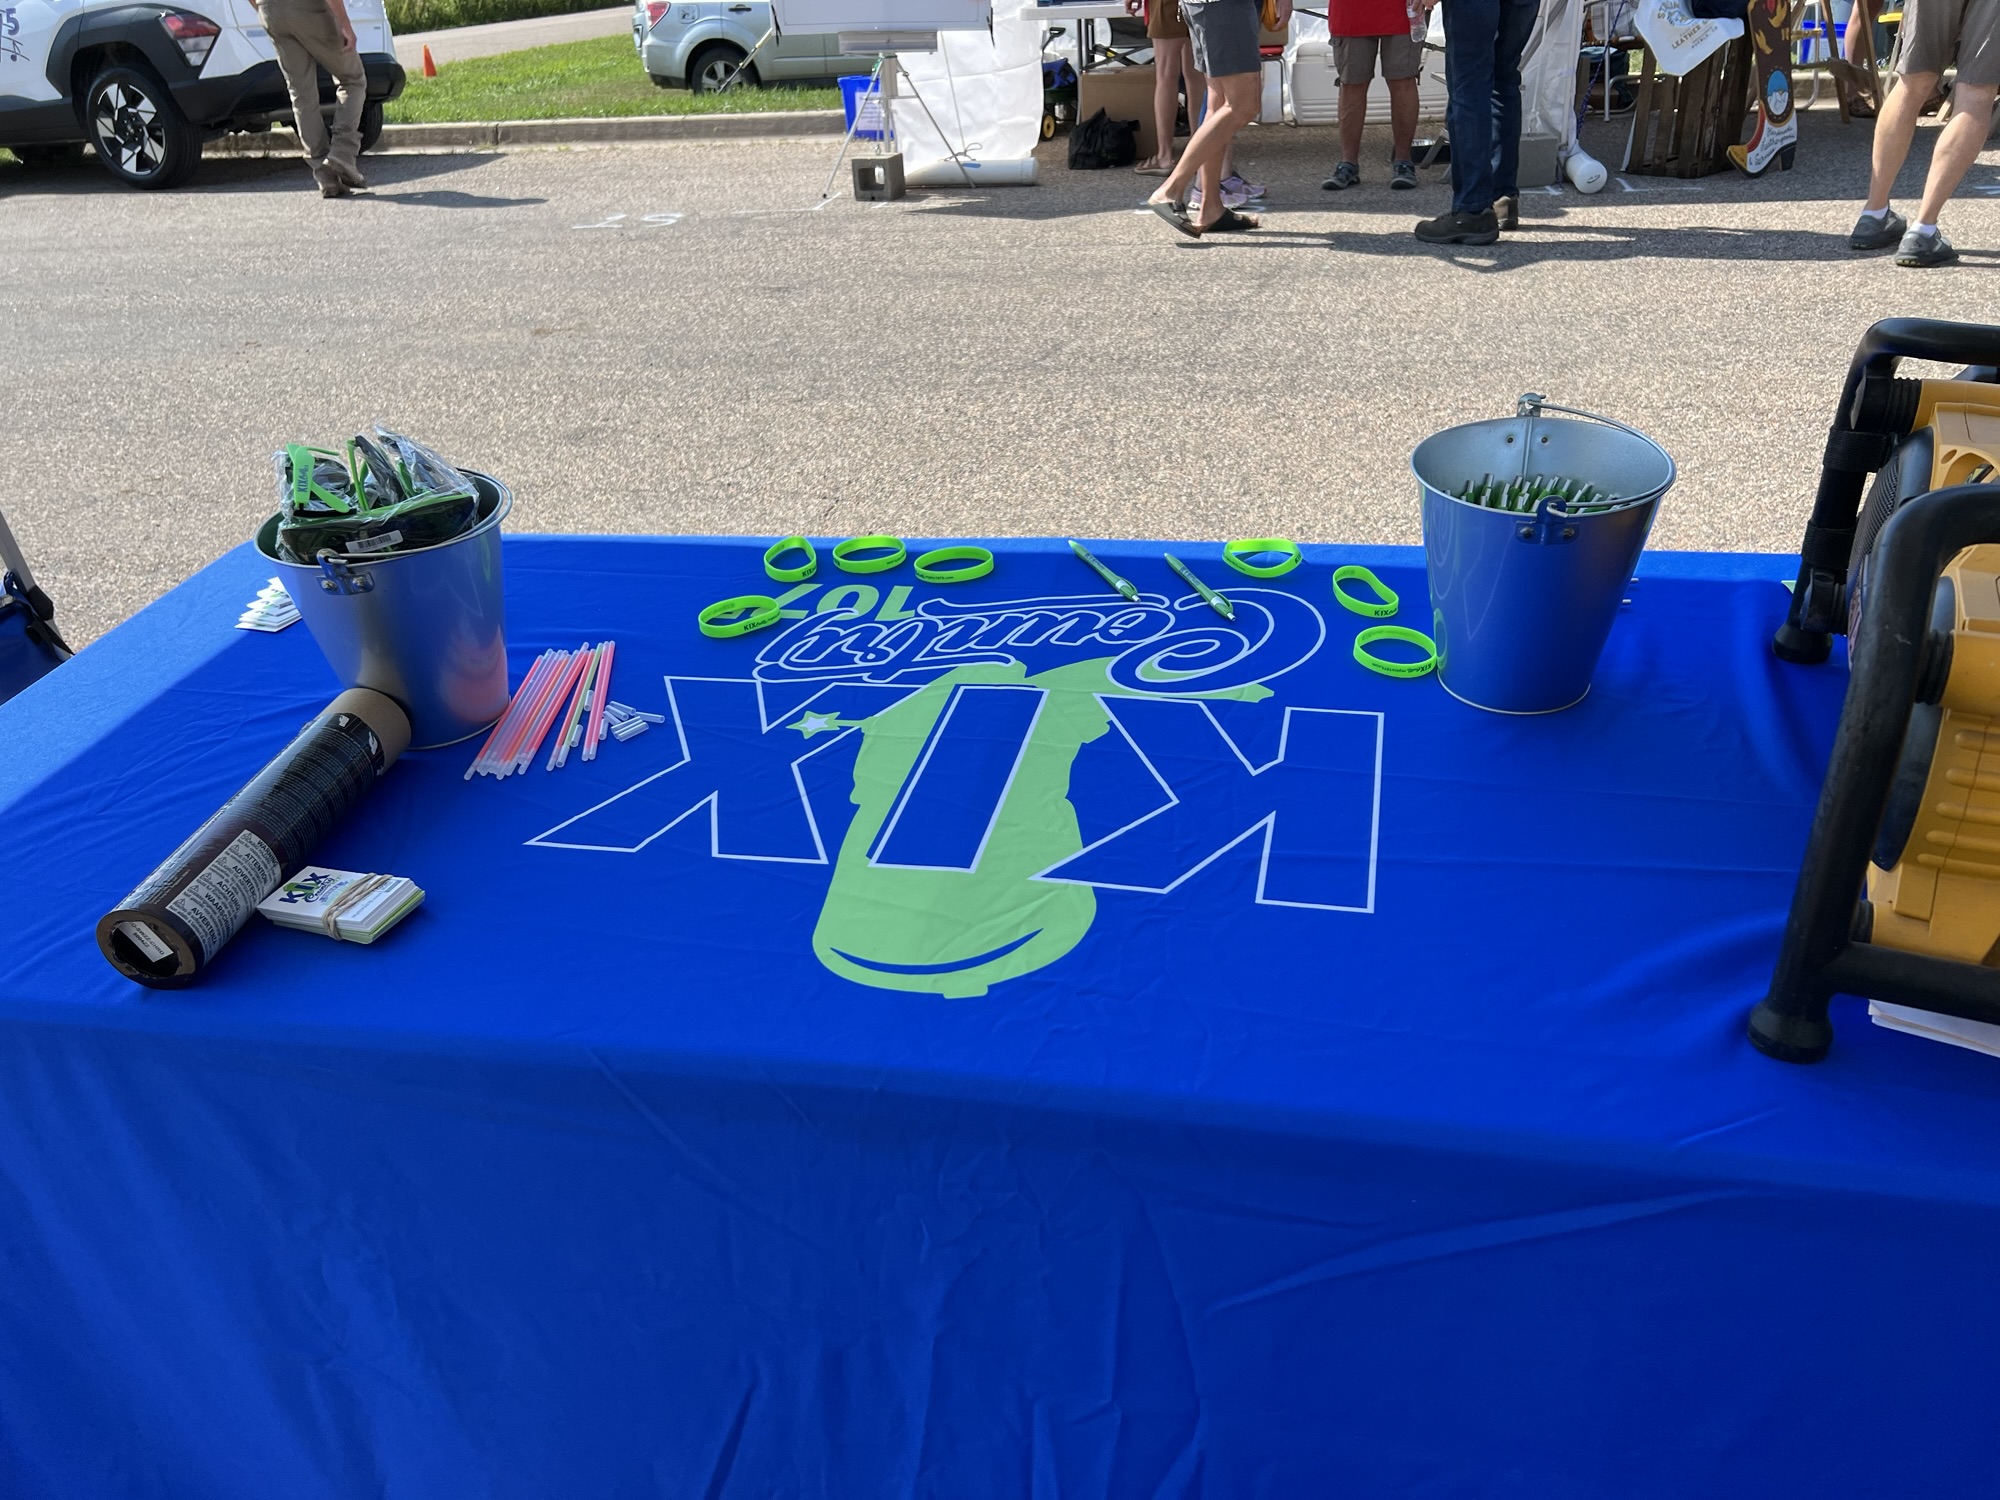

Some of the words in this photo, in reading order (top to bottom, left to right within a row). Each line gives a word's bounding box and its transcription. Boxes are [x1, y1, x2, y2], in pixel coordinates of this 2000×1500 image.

[1672, 25, 1701, 49] LEATHER
[802, 568, 813, 578] KIX
[743, 622, 756, 631] KIX
[1374, 609, 1389, 617] KIX
[752, 587, 1327, 697] Country
[1420, 663, 1433, 673] KIX
[524, 676, 1385, 914] KIX
[256, 839, 278, 867] WARNING
[245, 853, 267, 883] ATTENTION
[279, 872, 331, 904] KIX
[305, 877, 335, 903] Country
[190, 907, 217, 943] AVVERTENZA
